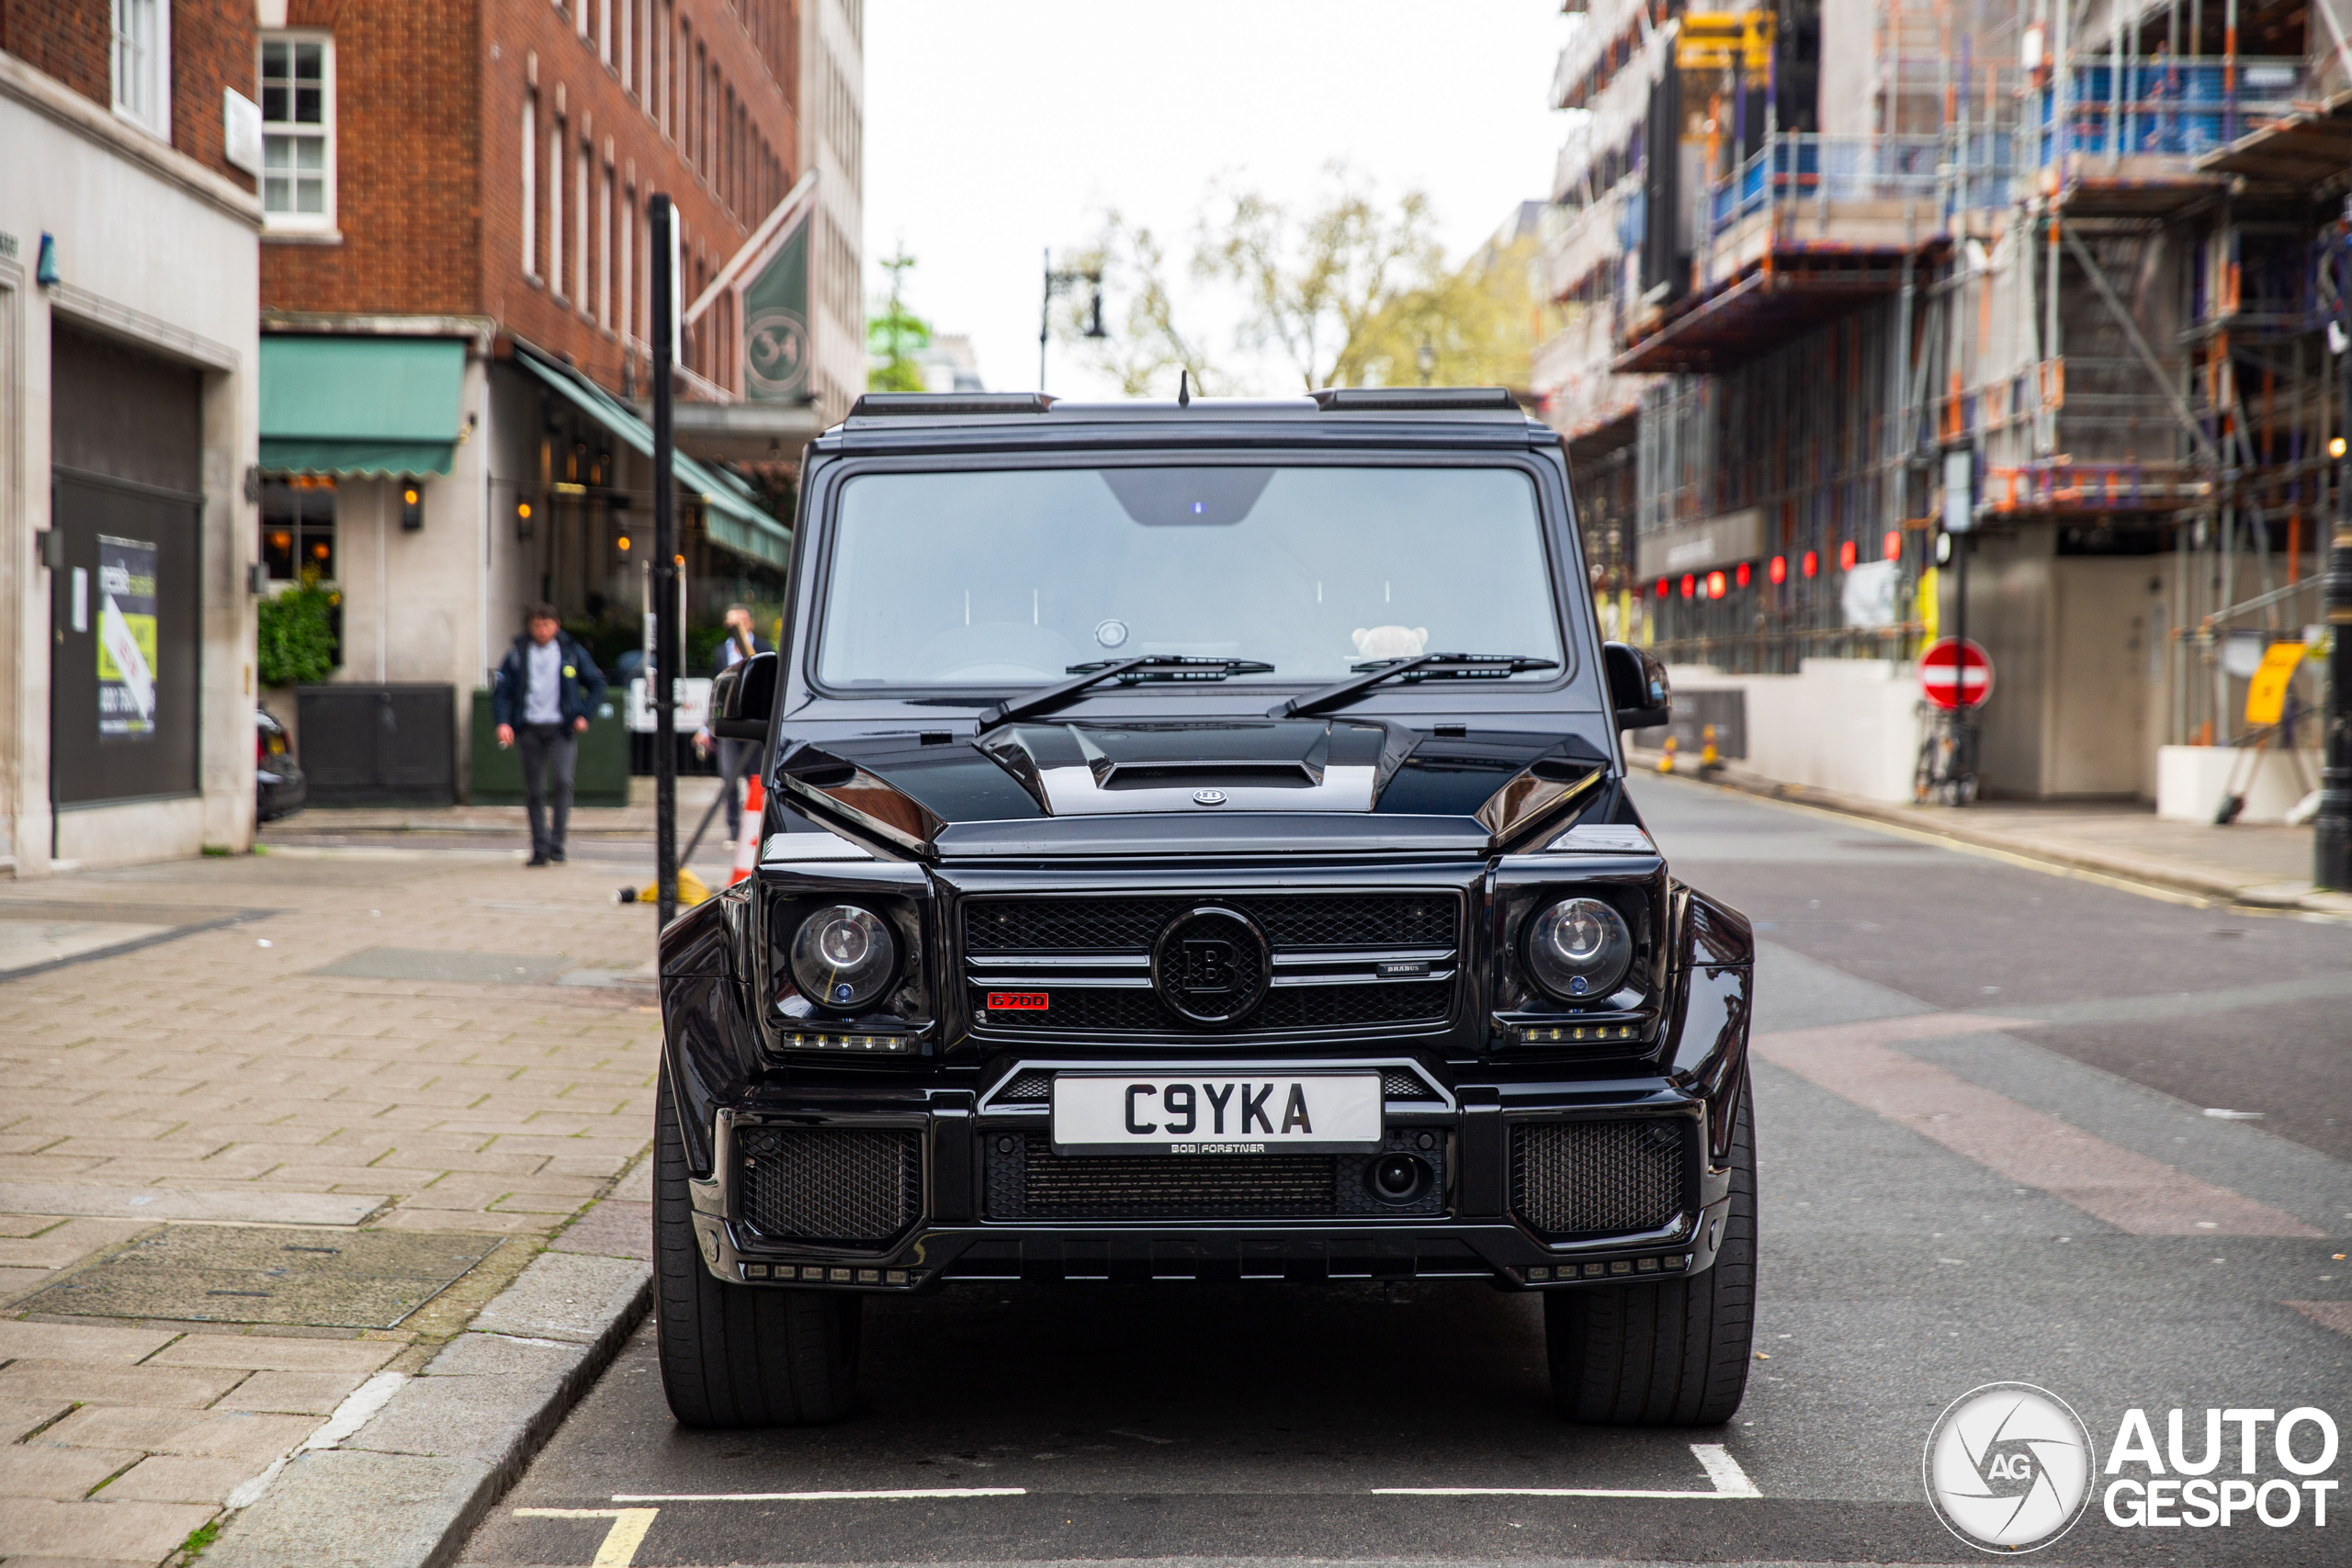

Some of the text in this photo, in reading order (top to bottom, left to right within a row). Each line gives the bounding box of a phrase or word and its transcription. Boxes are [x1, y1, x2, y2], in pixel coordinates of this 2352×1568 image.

[1125, 1083, 1313, 1134] C9YKA
[1170, 1144, 1265, 1154] BOB FORSTNER
